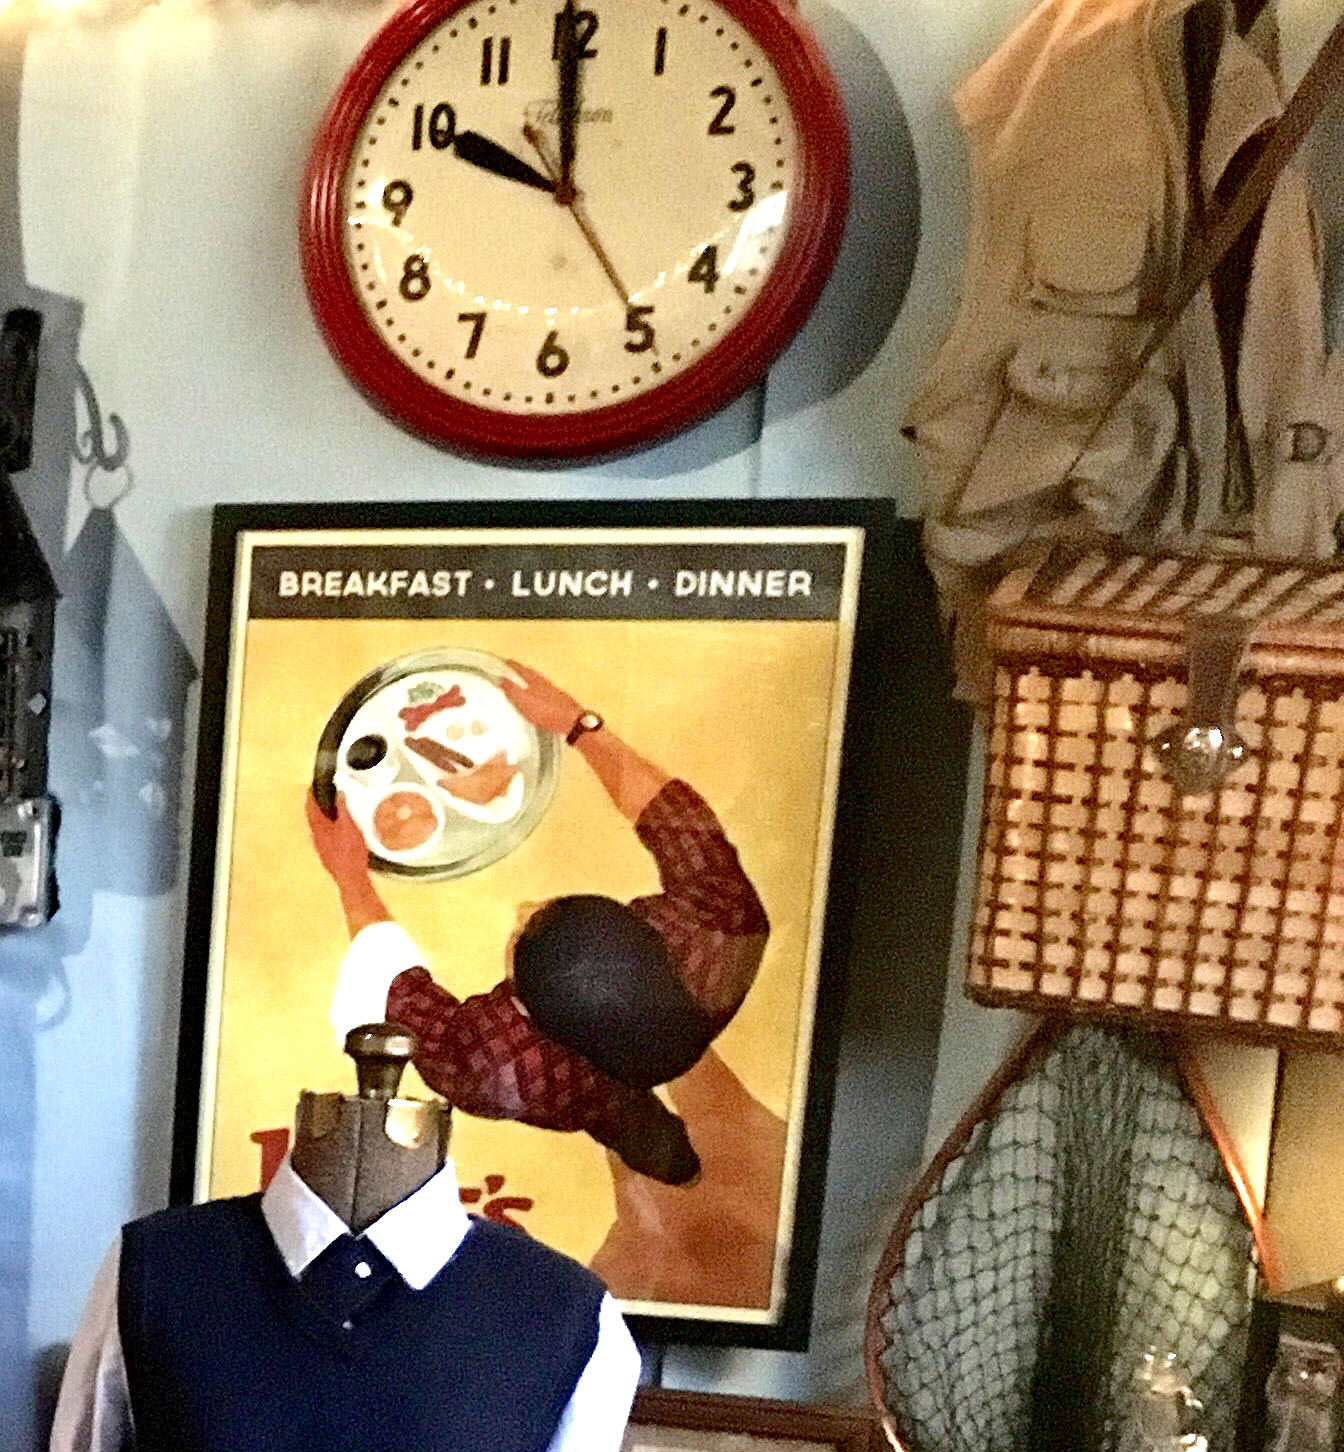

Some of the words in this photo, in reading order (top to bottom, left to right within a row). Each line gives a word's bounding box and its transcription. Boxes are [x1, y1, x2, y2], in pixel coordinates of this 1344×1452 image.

[552, 10, 599, 61] 12
[653, 27, 668, 76] 1
[480, 36, 512, 86] 11
[412, 102, 457, 151] 10
[707, 86, 737, 136] 2
[381, 180, 414, 227] 9
[727, 162, 756, 212] 3
[398, 254, 432, 301] 8
[687, 245, 719, 294] 4
[457, 312, 489, 360] 7
[535, 329, 570, 378] 6
[624, 305, 656, 354] 5
[279, 570, 472, 598] BREAKFAST
[512, 569, 633, 598] LUNCH
[675, 569, 812, 598] DINNER
